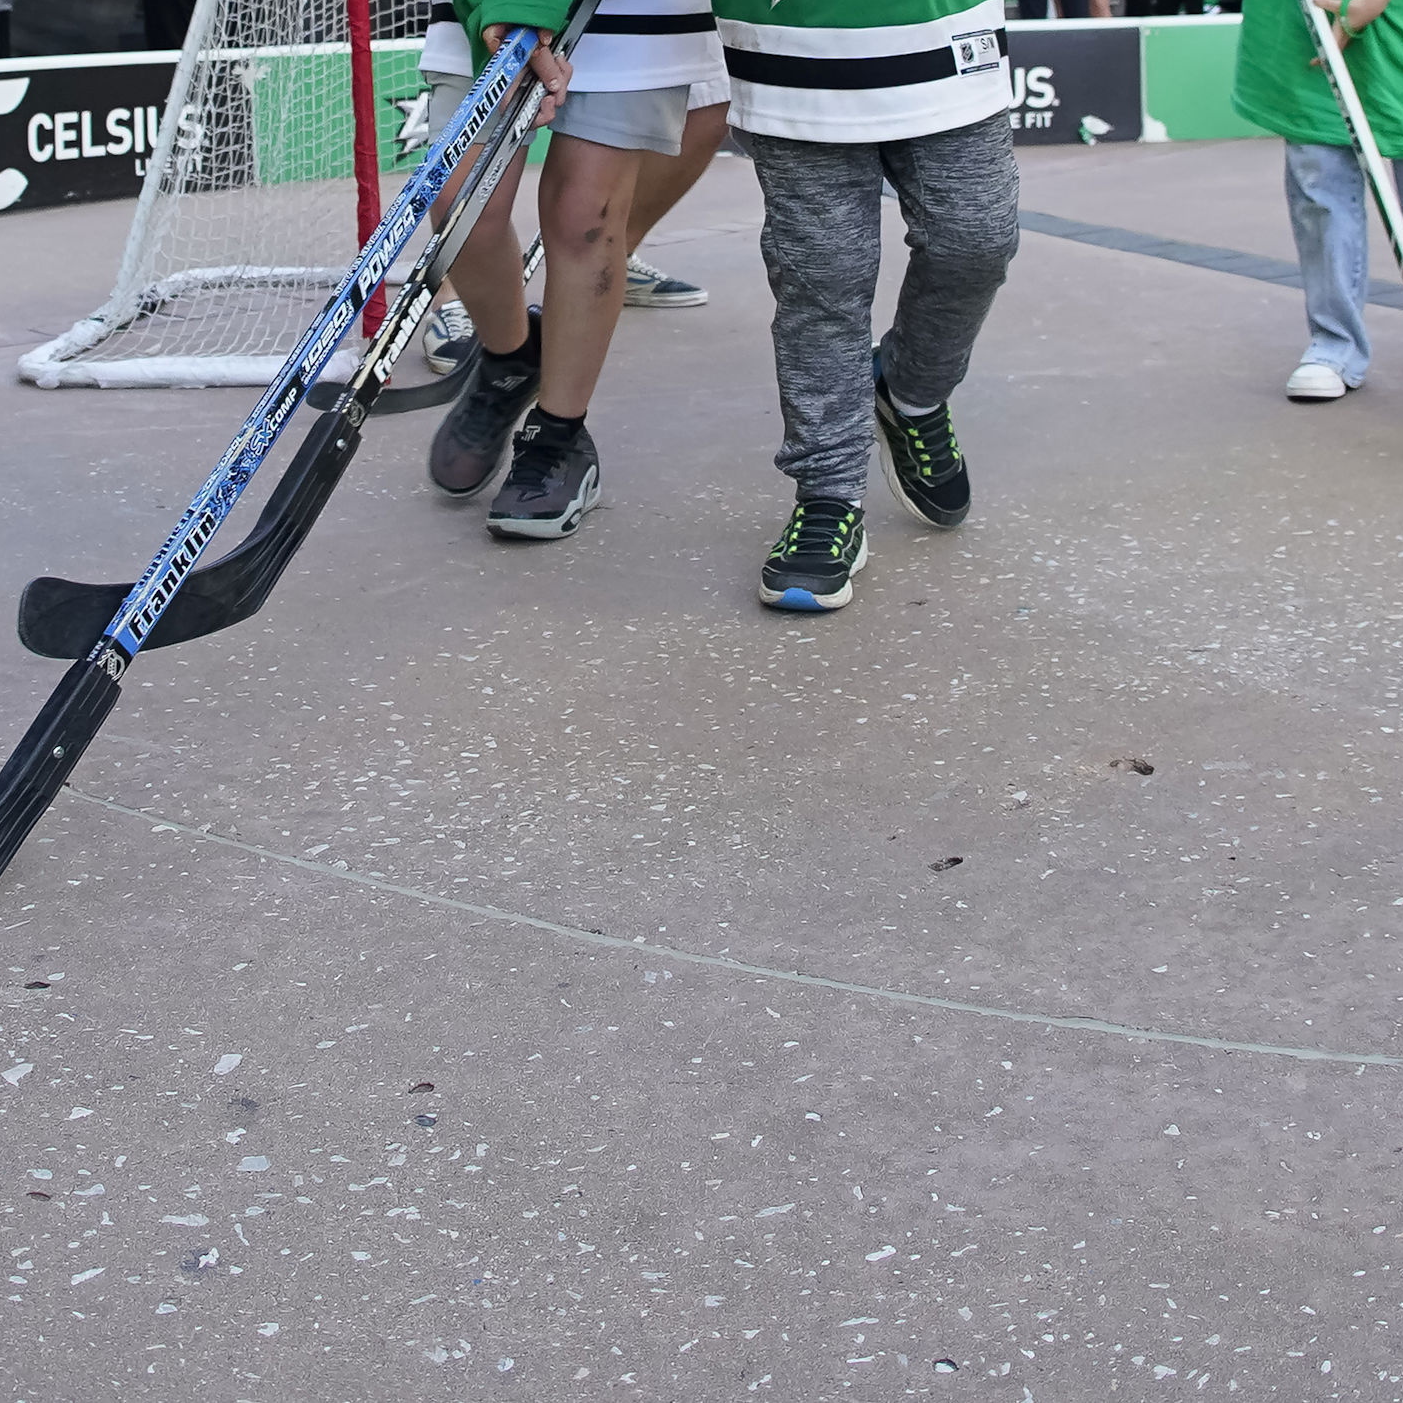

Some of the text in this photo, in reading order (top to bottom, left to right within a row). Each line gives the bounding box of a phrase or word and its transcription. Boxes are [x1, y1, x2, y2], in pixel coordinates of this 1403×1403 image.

[437, 70, 513, 170] Franklin
[1025, 111, 1054, 129] FIT
[368, 283, 439, 383] Franklin
[266, 385, 302, 432] COMP
[121, 507, 223, 644] Franklin
